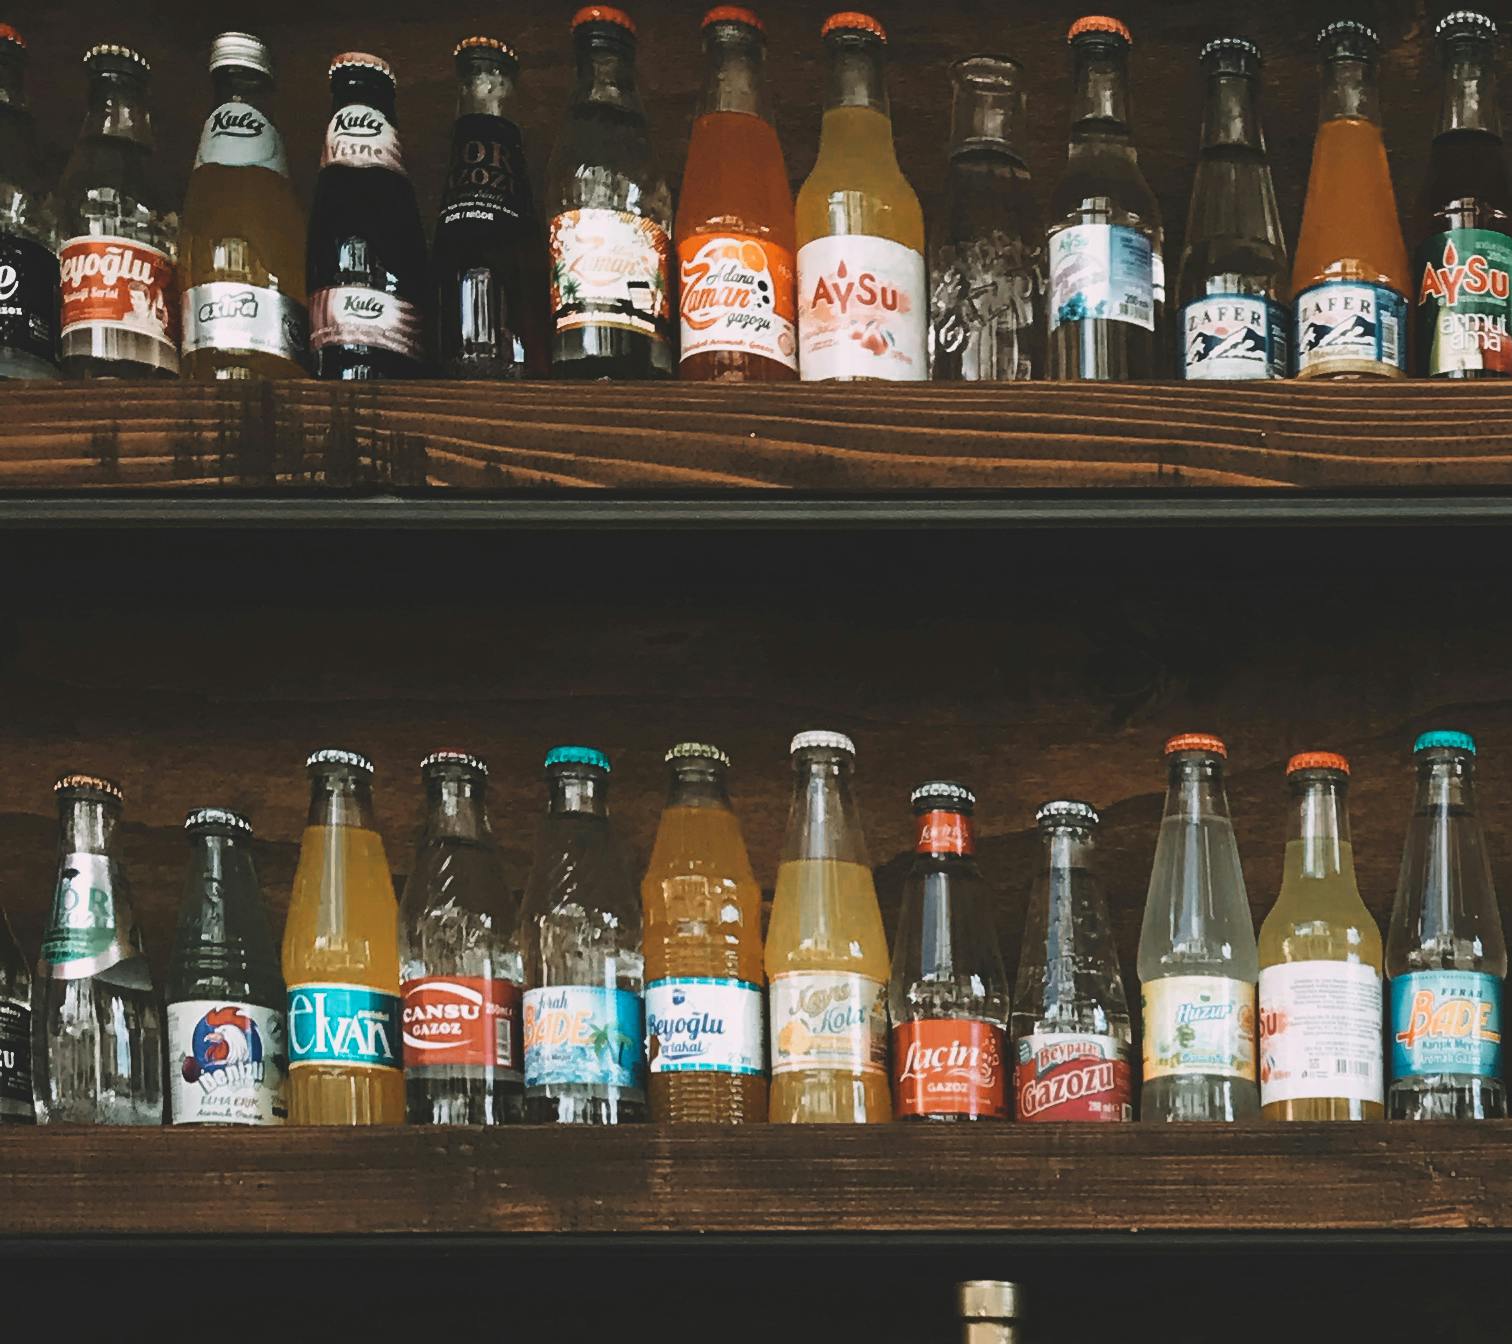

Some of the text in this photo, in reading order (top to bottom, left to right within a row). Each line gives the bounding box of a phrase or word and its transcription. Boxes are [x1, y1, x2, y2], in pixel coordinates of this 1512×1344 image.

[211, 111, 266, 137] Kula
[333, 112, 384, 138] Kula
[61, 245, 155, 287] eyoğlu
[344, 295, 386, 319] Kula
[1187, 305, 1263, 332] ZAFER
[1301, 293, 1371, 321] ZAFER
[727, 311, 771, 331] gazozu
[1440, 312, 1507, 341] armut
[402, 1001, 481, 1022] CANSU
[1396, 990, 1501, 1049] BADE
[412, 1021, 463, 1038] GAZOZ
[948, 1083, 989, 1094] GAZOZ
[1020, 1062, 1115, 1118] Gazozu
